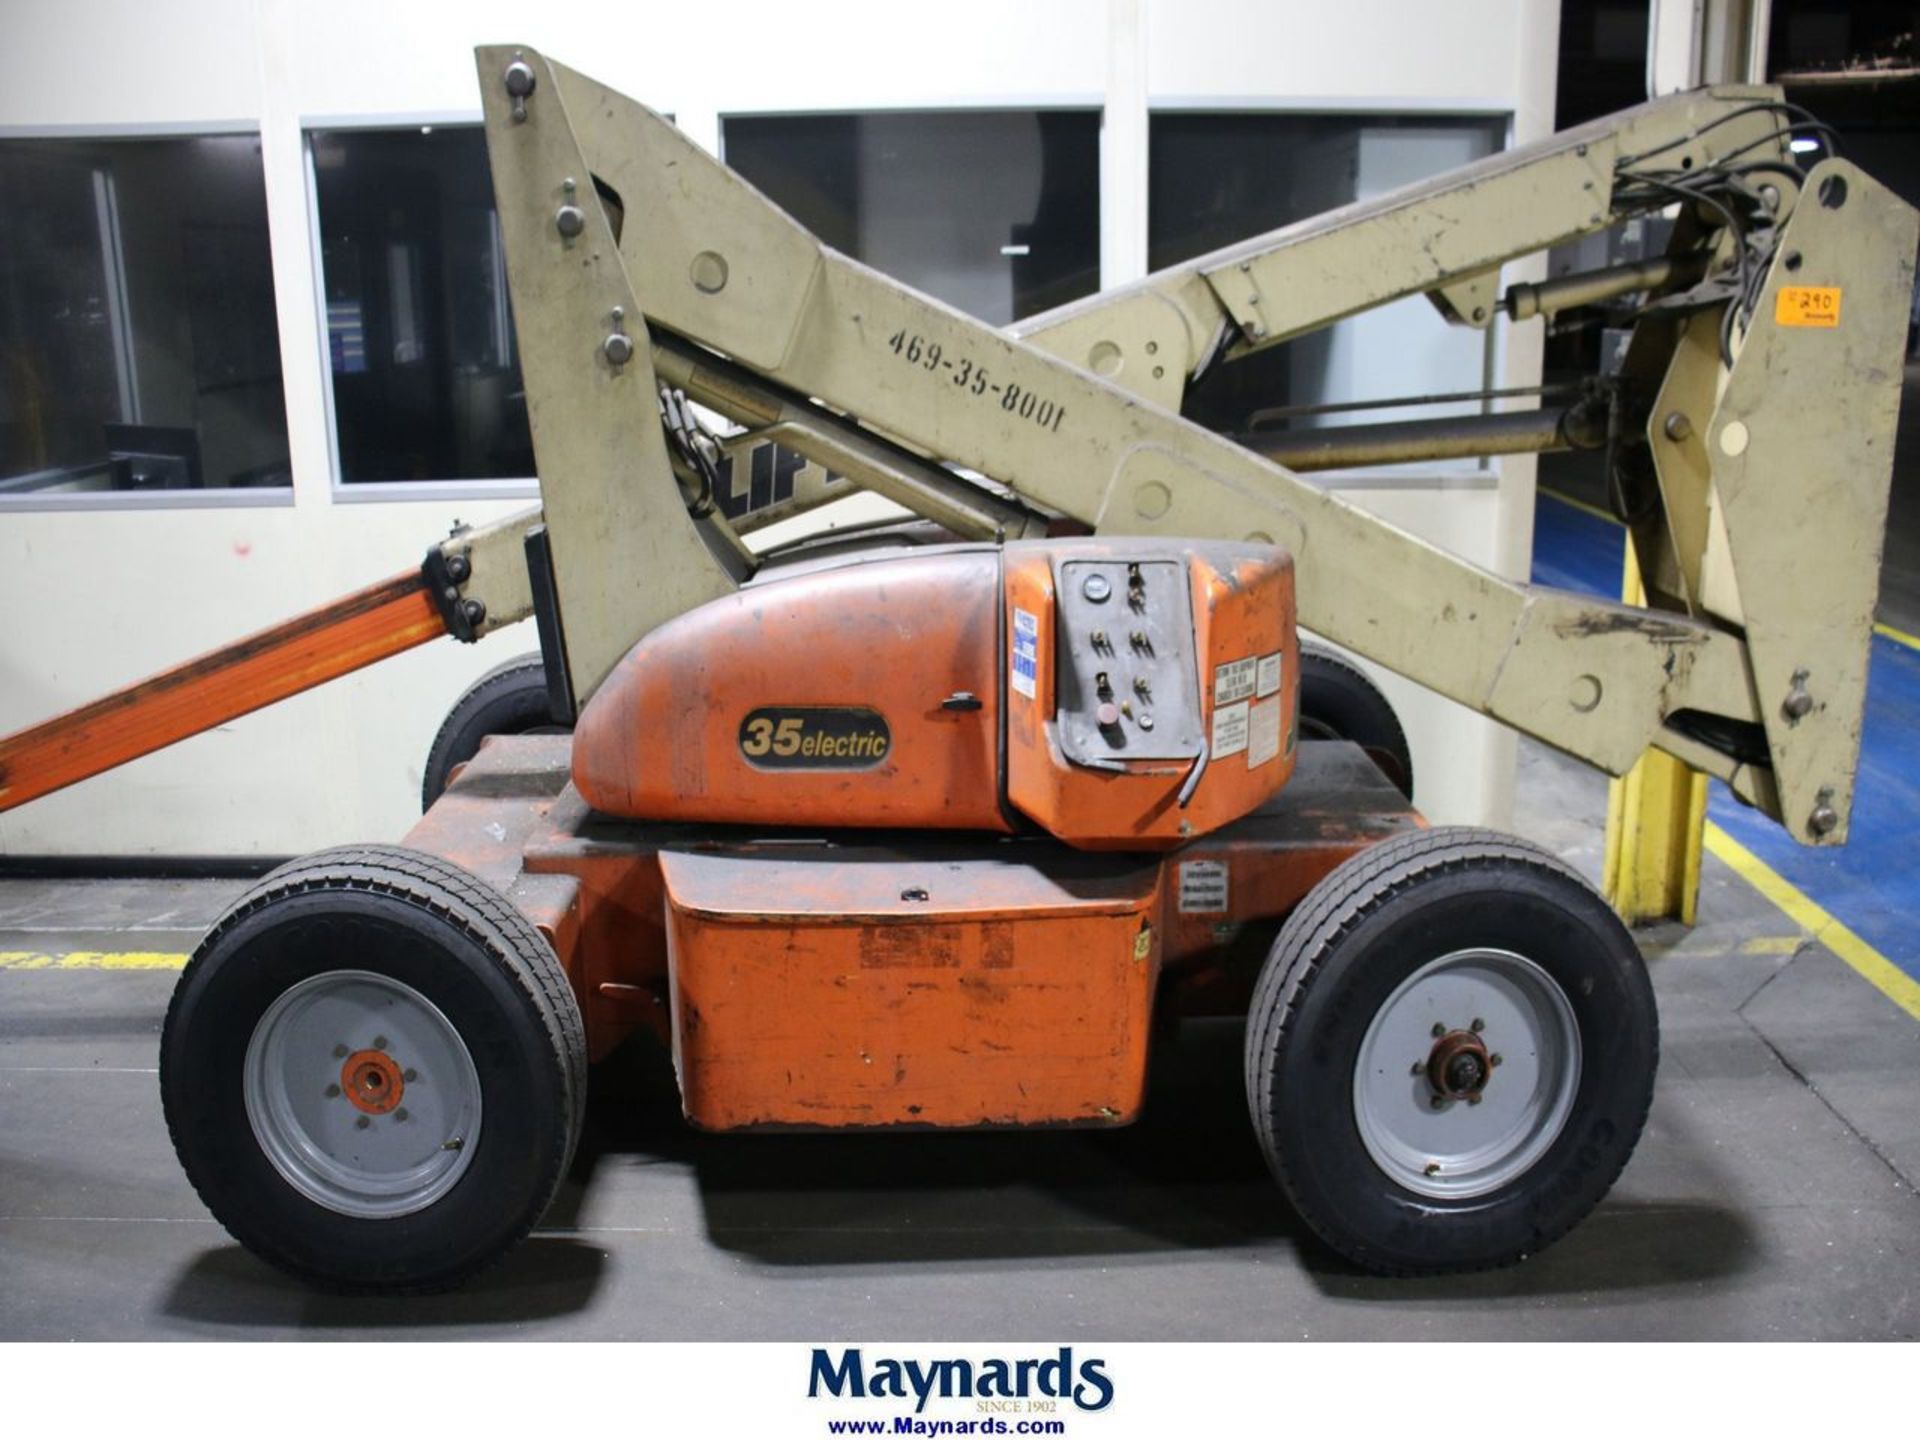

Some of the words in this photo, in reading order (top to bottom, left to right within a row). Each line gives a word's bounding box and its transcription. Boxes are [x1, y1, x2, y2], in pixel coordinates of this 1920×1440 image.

[1799, 292, 1832, 310] 290
[889, 329, 1065, 433] 469-35-8001
[713, 441, 846, 521] LIF
